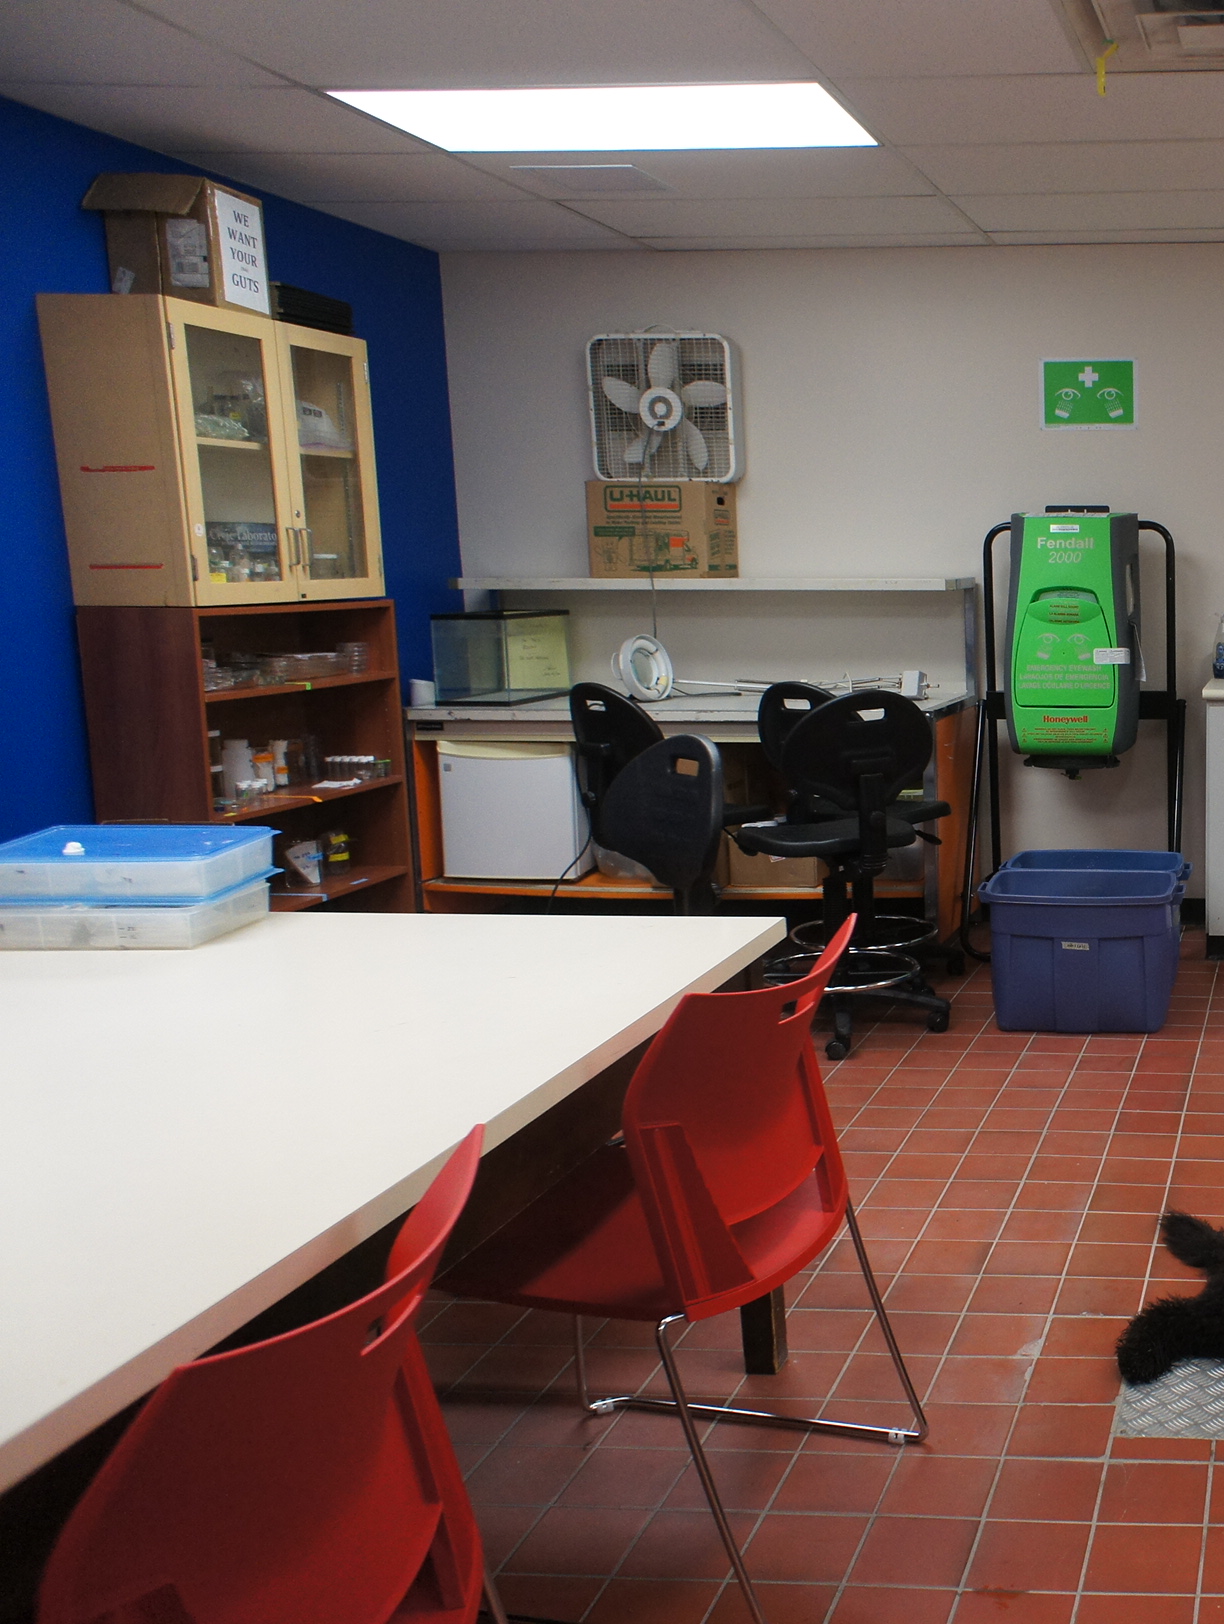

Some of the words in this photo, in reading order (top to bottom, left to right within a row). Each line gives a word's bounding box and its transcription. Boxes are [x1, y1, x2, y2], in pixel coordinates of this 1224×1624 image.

[233, 210, 249, 228] WE
[227, 226, 258, 249] WANT
[230, 246, 258, 268] YOUR
[232, 273, 259, 294] GUTS
[1037, 537, 1095, 549] Fendall
[1048, 551, 1082, 564] 2000
[1026, 664, 1067, 672] EMERGENCY
[1069, 664, 1102, 672] EYEWASH
[1043, 715, 1089, 725] Honeywell
